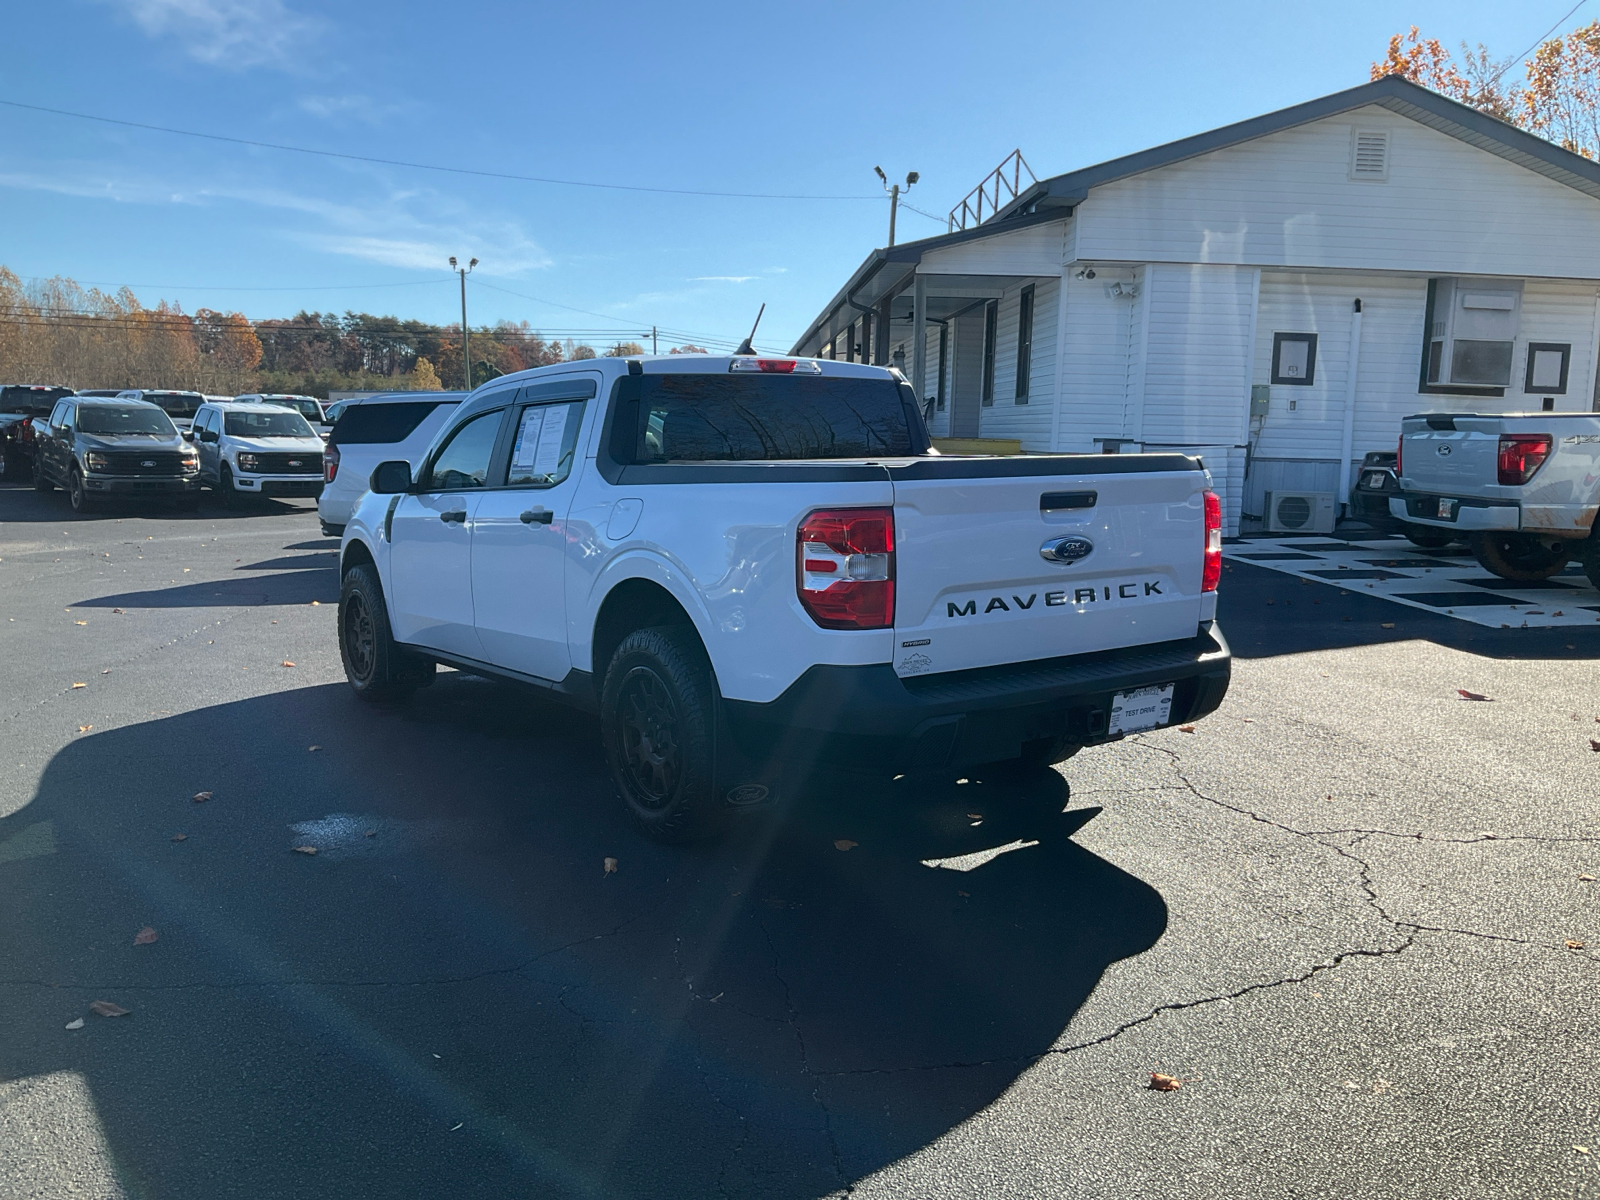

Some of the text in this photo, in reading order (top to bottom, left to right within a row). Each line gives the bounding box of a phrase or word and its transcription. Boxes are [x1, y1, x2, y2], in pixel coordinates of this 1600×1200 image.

[1563, 434, 1600, 445] 4X
[947, 580, 1163, 618] MAVERICK
[903, 639, 930, 647] HYBRID
[1125, 709, 1139, 717] TEST
[1140, 706, 1156, 715] DRIVE
